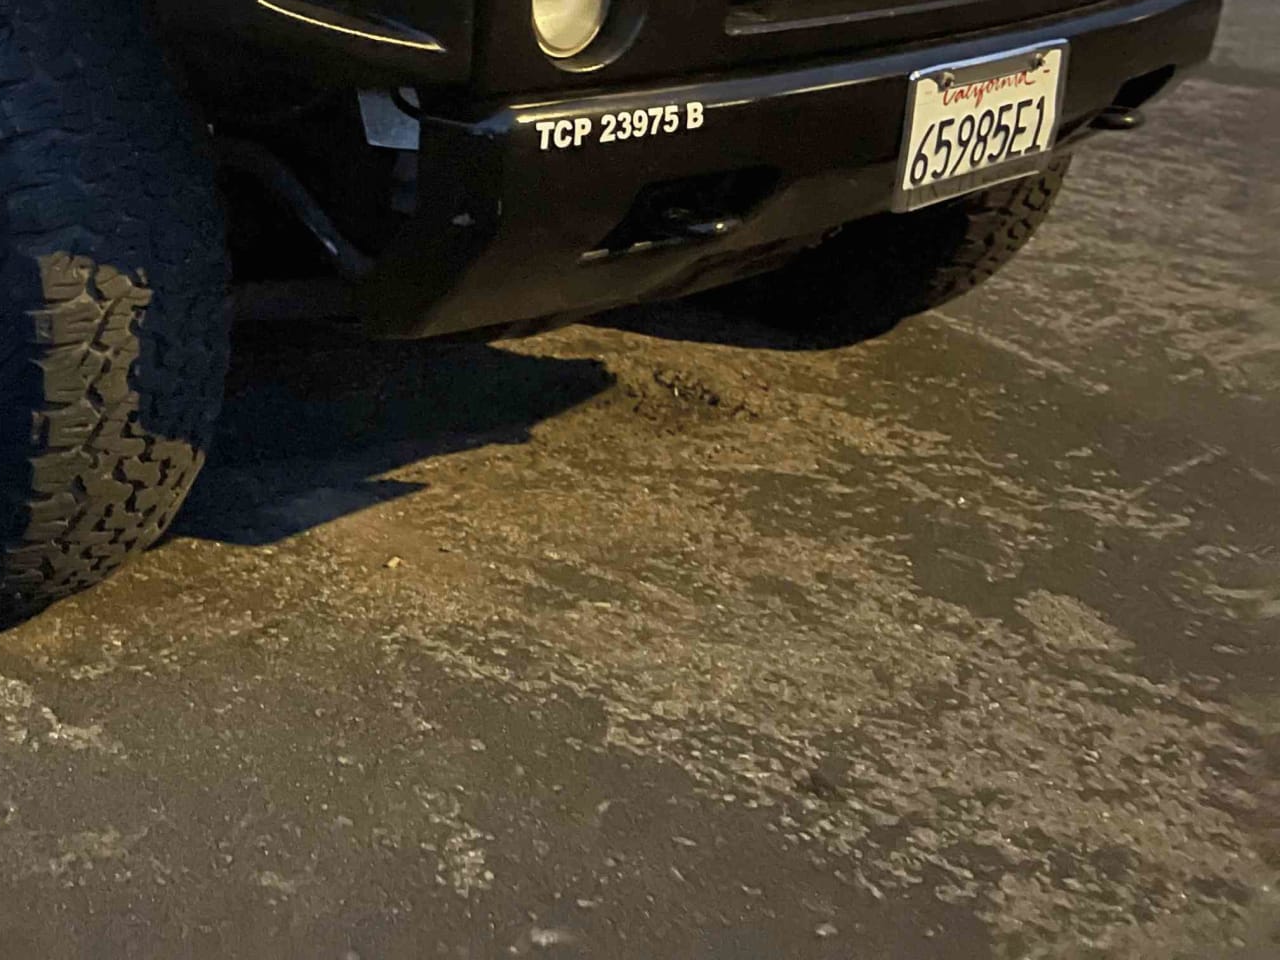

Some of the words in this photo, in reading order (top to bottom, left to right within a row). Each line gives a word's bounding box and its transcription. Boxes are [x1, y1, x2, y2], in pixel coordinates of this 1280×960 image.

[535, 117, 592, 150] TCP
[599, 105, 679, 143] 23975
[686, 101, 705, 130] B
[909, 95, 1046, 185] 65985E1
